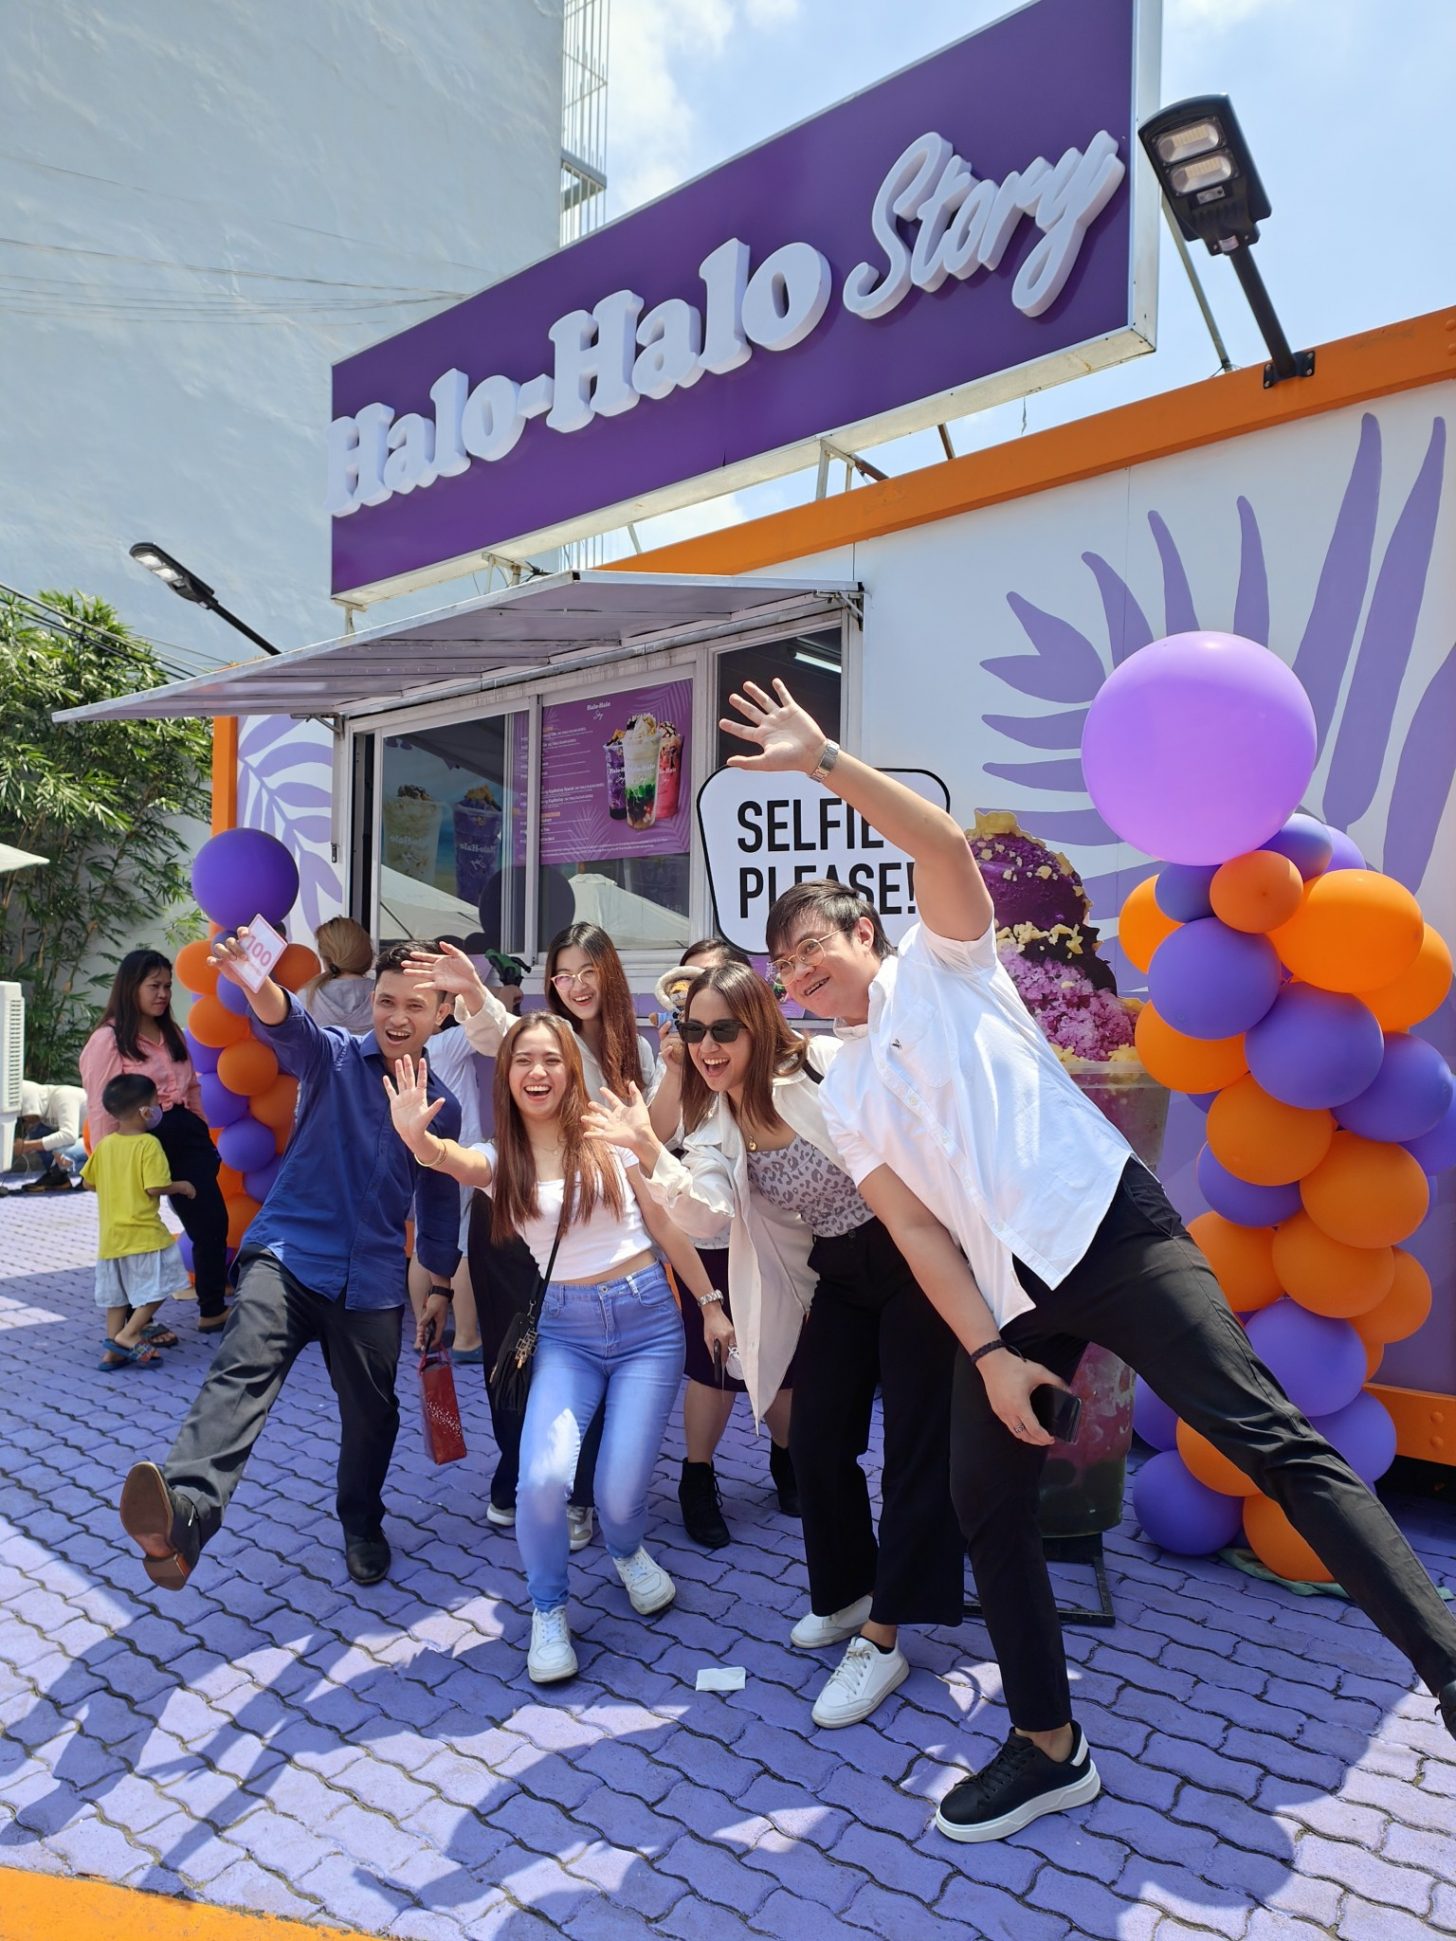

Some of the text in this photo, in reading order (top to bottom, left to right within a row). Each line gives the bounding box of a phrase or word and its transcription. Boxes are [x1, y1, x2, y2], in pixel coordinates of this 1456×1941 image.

[325, 130, 1125, 518] Halo-Halo Story
[737, 797, 884, 853] SELFIE
[739, 862, 916, 919] PSE!
